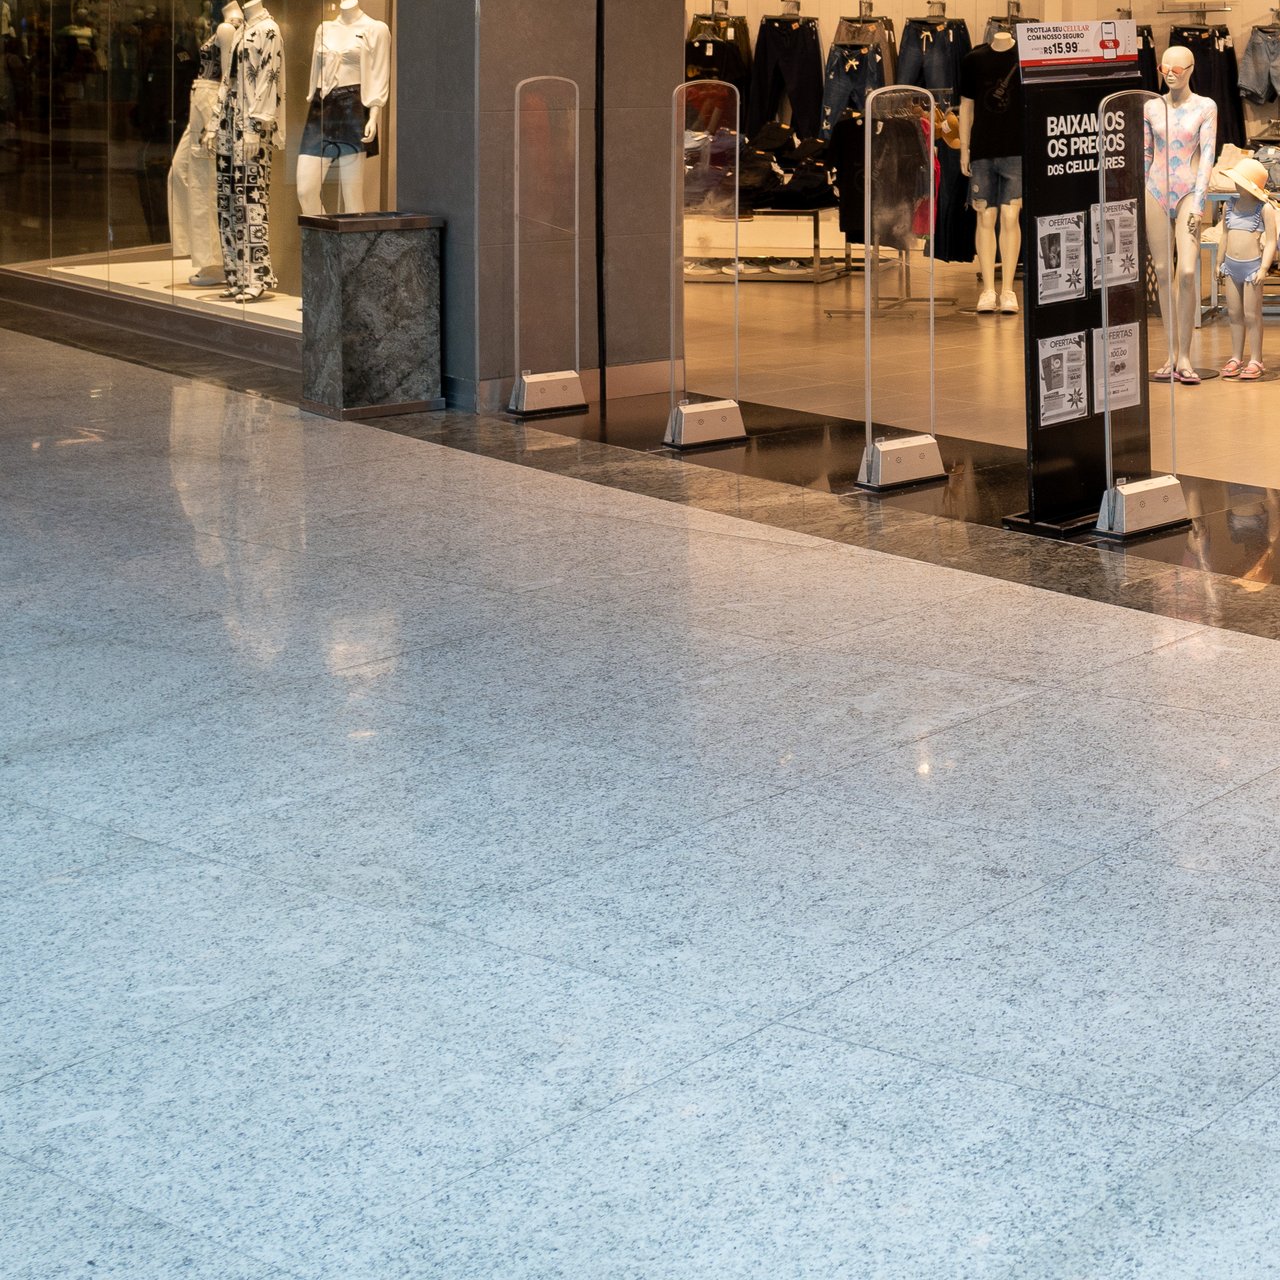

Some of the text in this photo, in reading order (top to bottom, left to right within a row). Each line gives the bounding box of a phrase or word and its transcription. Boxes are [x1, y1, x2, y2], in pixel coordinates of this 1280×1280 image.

[1047, 111, 1125, 136] BAIXAMOS
[1048, 138, 1068, 158] OS
[1048, 156, 1125, 176] DOS CELULARES
[1049, 217, 1075, 227] OFERTAS
[1101, 329, 1133, 340] FERTAS
[1050, 338, 1077, 348] OFERTAS
